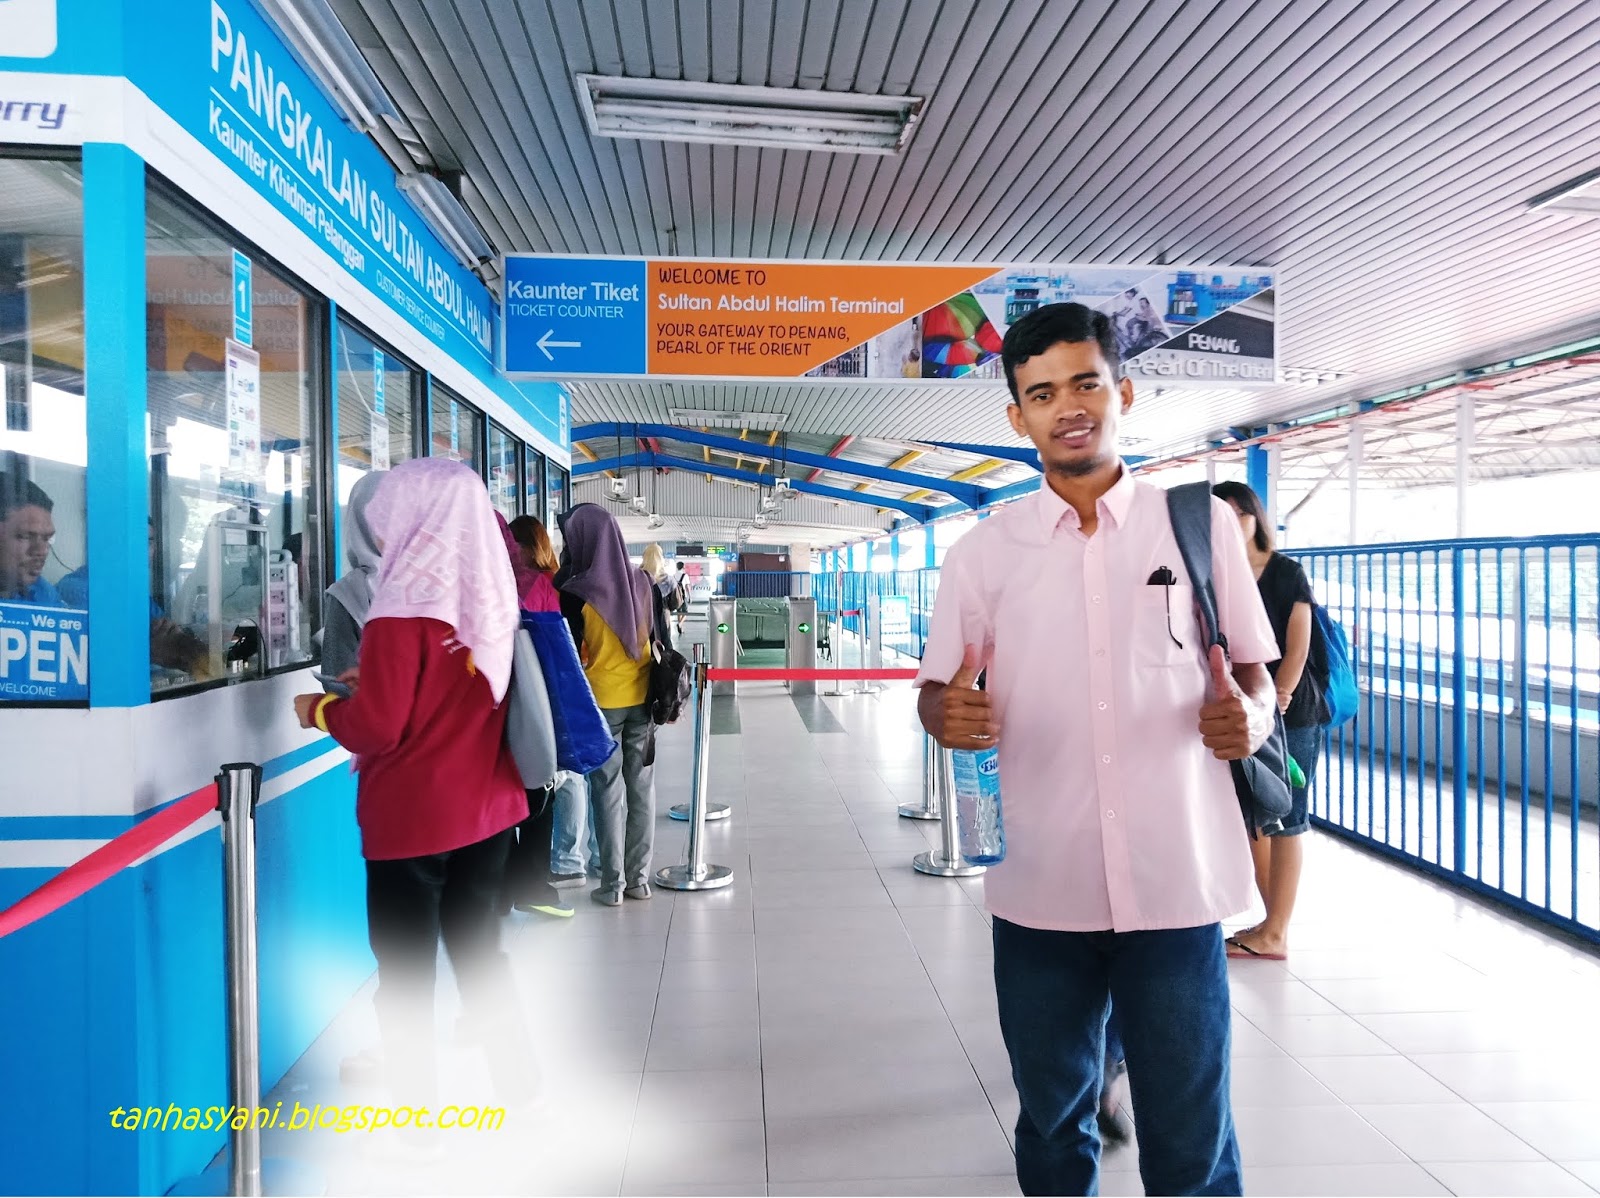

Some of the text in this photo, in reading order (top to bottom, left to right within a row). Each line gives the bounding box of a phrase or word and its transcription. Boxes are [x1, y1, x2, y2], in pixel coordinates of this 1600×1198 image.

[0, 101, 67, 129] rry
[209, 99, 365, 273] Kaunter Khidmat Pelanggan
[210, 0, 491, 354] PANGKALAN SULTAN ABDUL HALIM
[659, 268, 766, 286] WELCOME TO
[237, 279, 247, 313] 1
[507, 280, 640, 302] Kaunter Tiket
[376, 269, 446, 341] CUSTOMER SERVICE COUNTER
[508, 303, 624, 318] TICKET COUNTER
[658, 293, 904, 314] Sultan Abdul Halim Terminal
[656, 322, 850, 342] YOUR GATEWAY TO PENANG,
[656, 340, 811, 356] PEARL OF THE ORIENT
[1188, 332, 1241, 354] PENANG
[1185, 357, 1207, 377] Of
[1208, 359, 1238, 378] The
[376, 368, 383, 393] 2
[731, 553, 737, 562] 2
[31, 613, 56, 628] We
[59, 619, 82, 630] are
